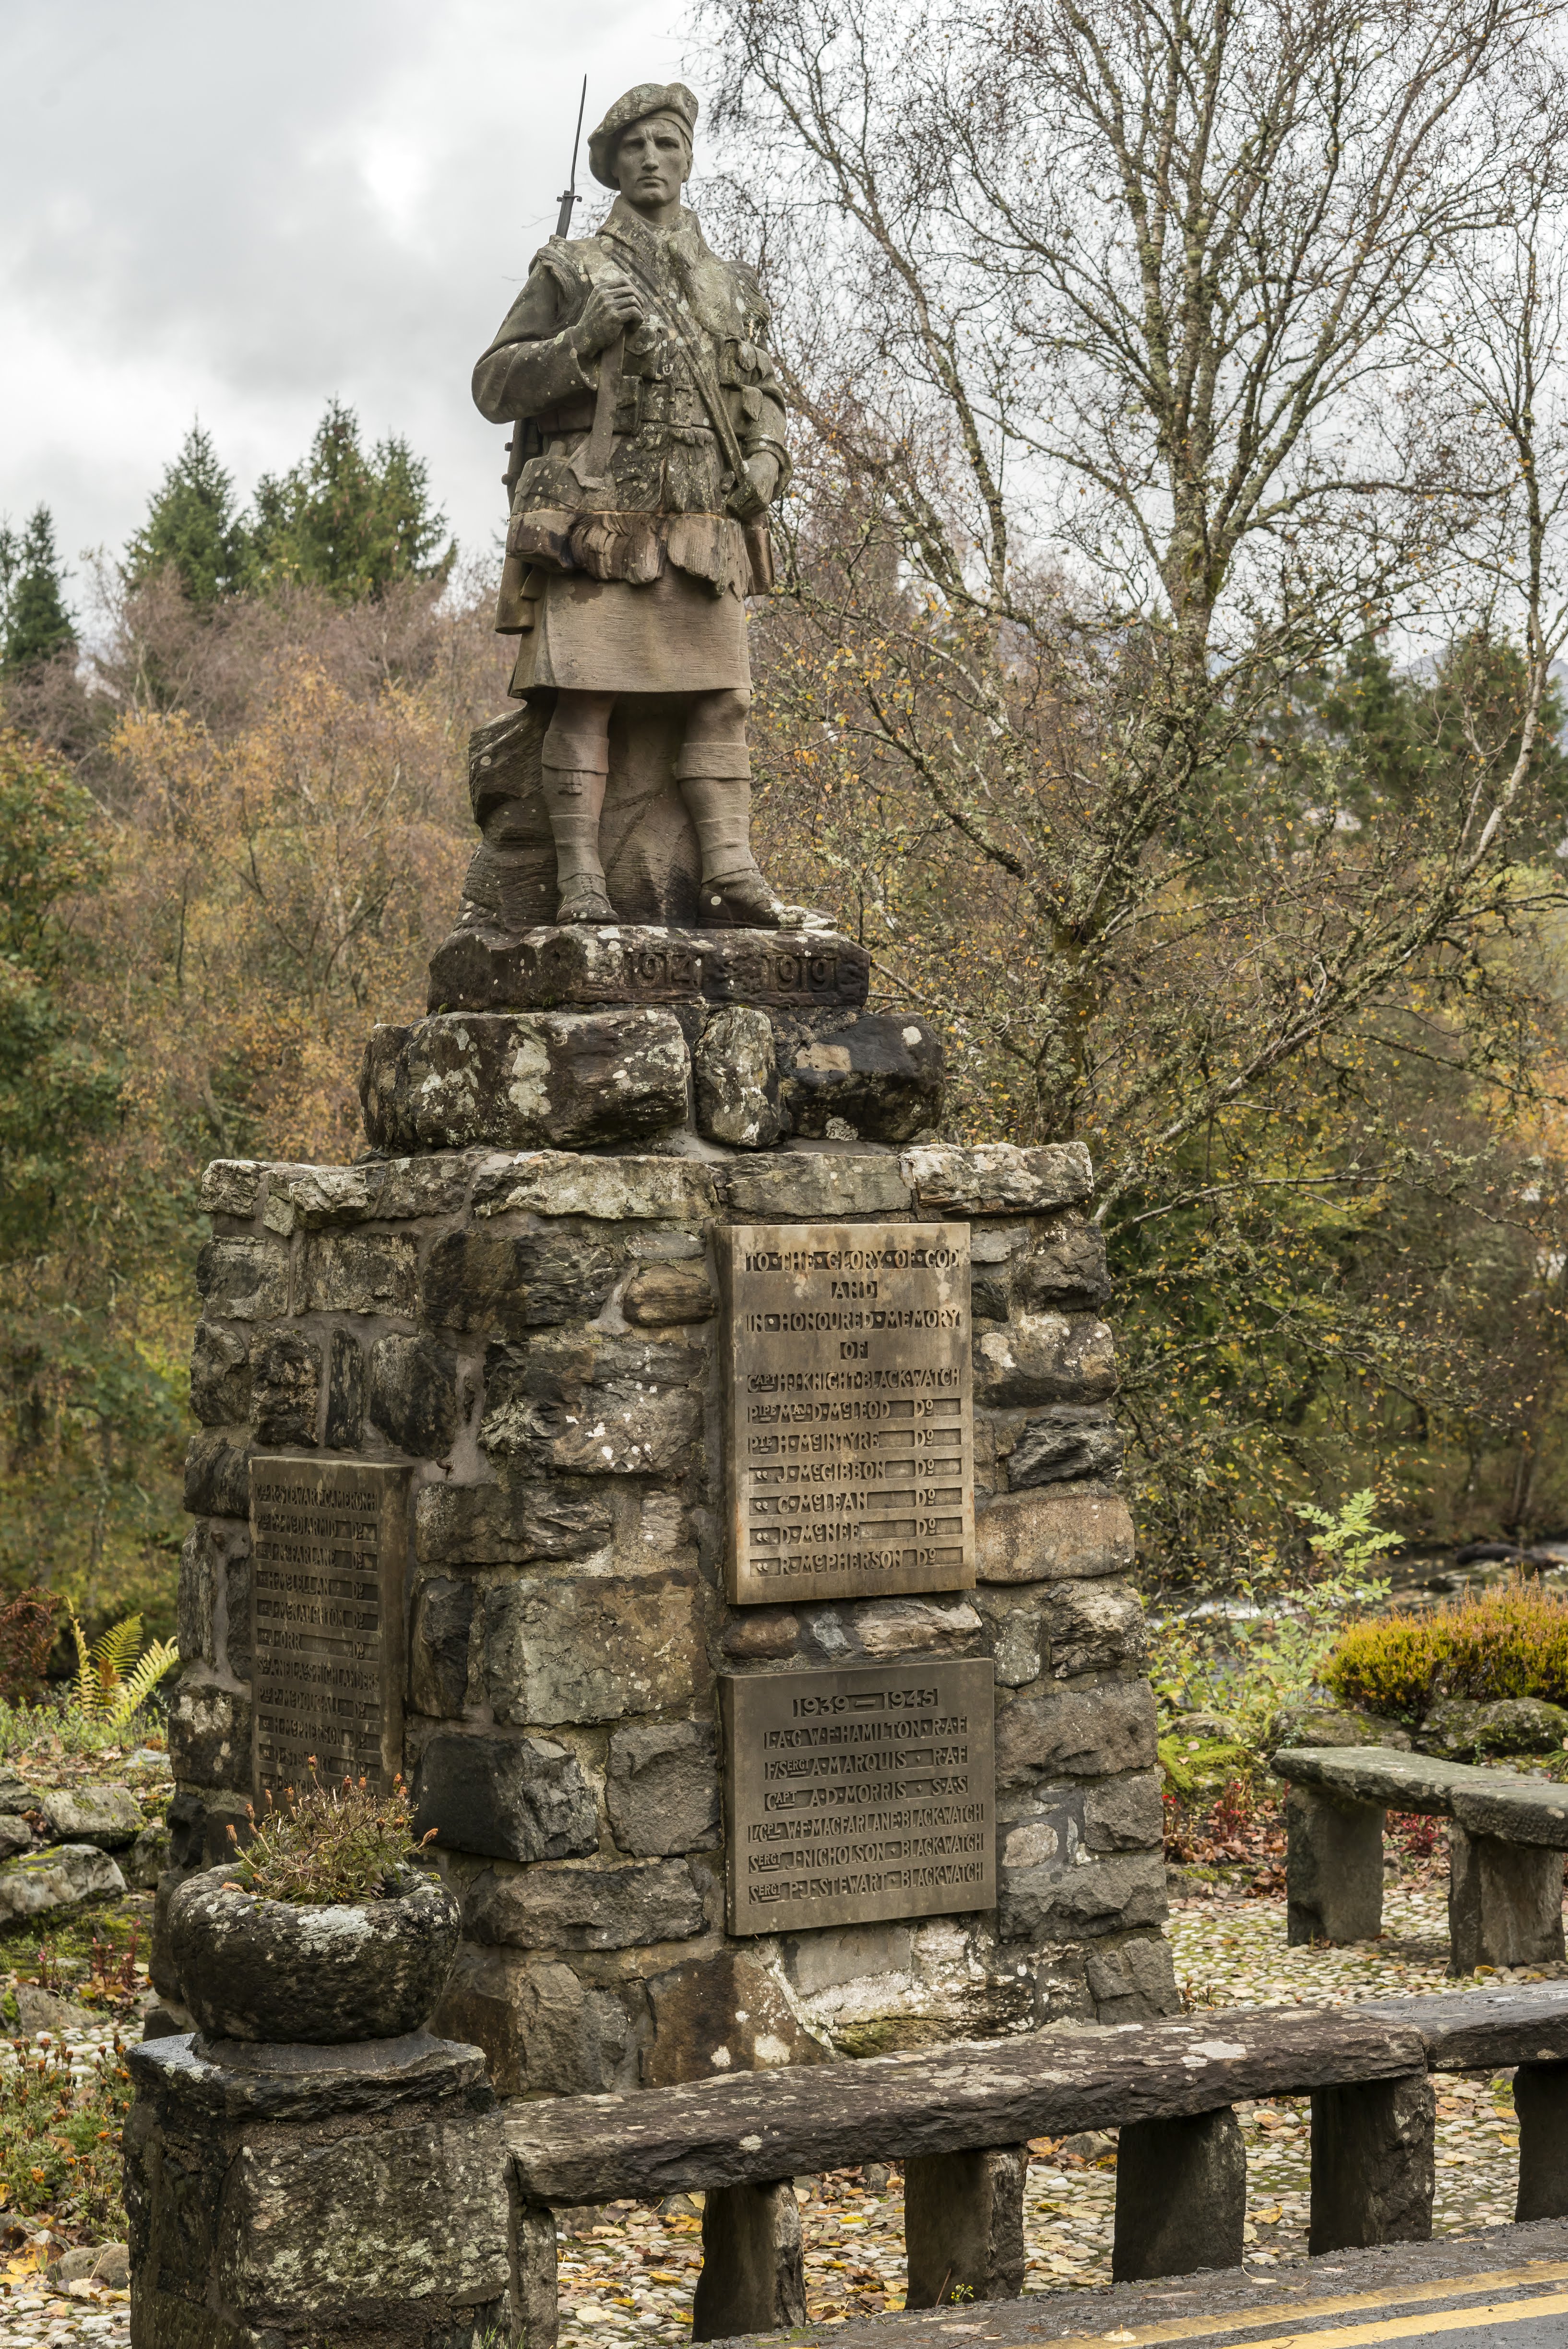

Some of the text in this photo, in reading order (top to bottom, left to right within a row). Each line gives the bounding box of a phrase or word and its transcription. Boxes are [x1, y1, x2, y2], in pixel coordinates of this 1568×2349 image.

[630, 953, 831, 992] 1914 1919
[747, 1249, 959, 1271] TO THE GLORY OF GOD
[832, 1281, 876, 1299] AND
[747, 1310, 959, 1332] IN HONOURED MEMORY
[843, 1342, 867, 1360] OF
[862, 1370, 907, 1390] BLACK
[910, 1368, 960, 1388] WATCH
[795, 1695, 850, 1718] 1939
[883, 1689, 936, 1711] 1945
[901, 1806, 940, 1828] BLACK
[941, 1803, 983, 1825] WATCH
[749, 1853, 782, 1874] SERGT
[901, 1837, 940, 1858] BLACK
[941, 1833, 983, 1855] WATCH
[749, 1883, 783, 1904] SERGT
[818, 1873, 887, 1898] STEWART
[901, 1866, 940, 1889] BLACK
[941, 1862, 983, 1885] WATCH
